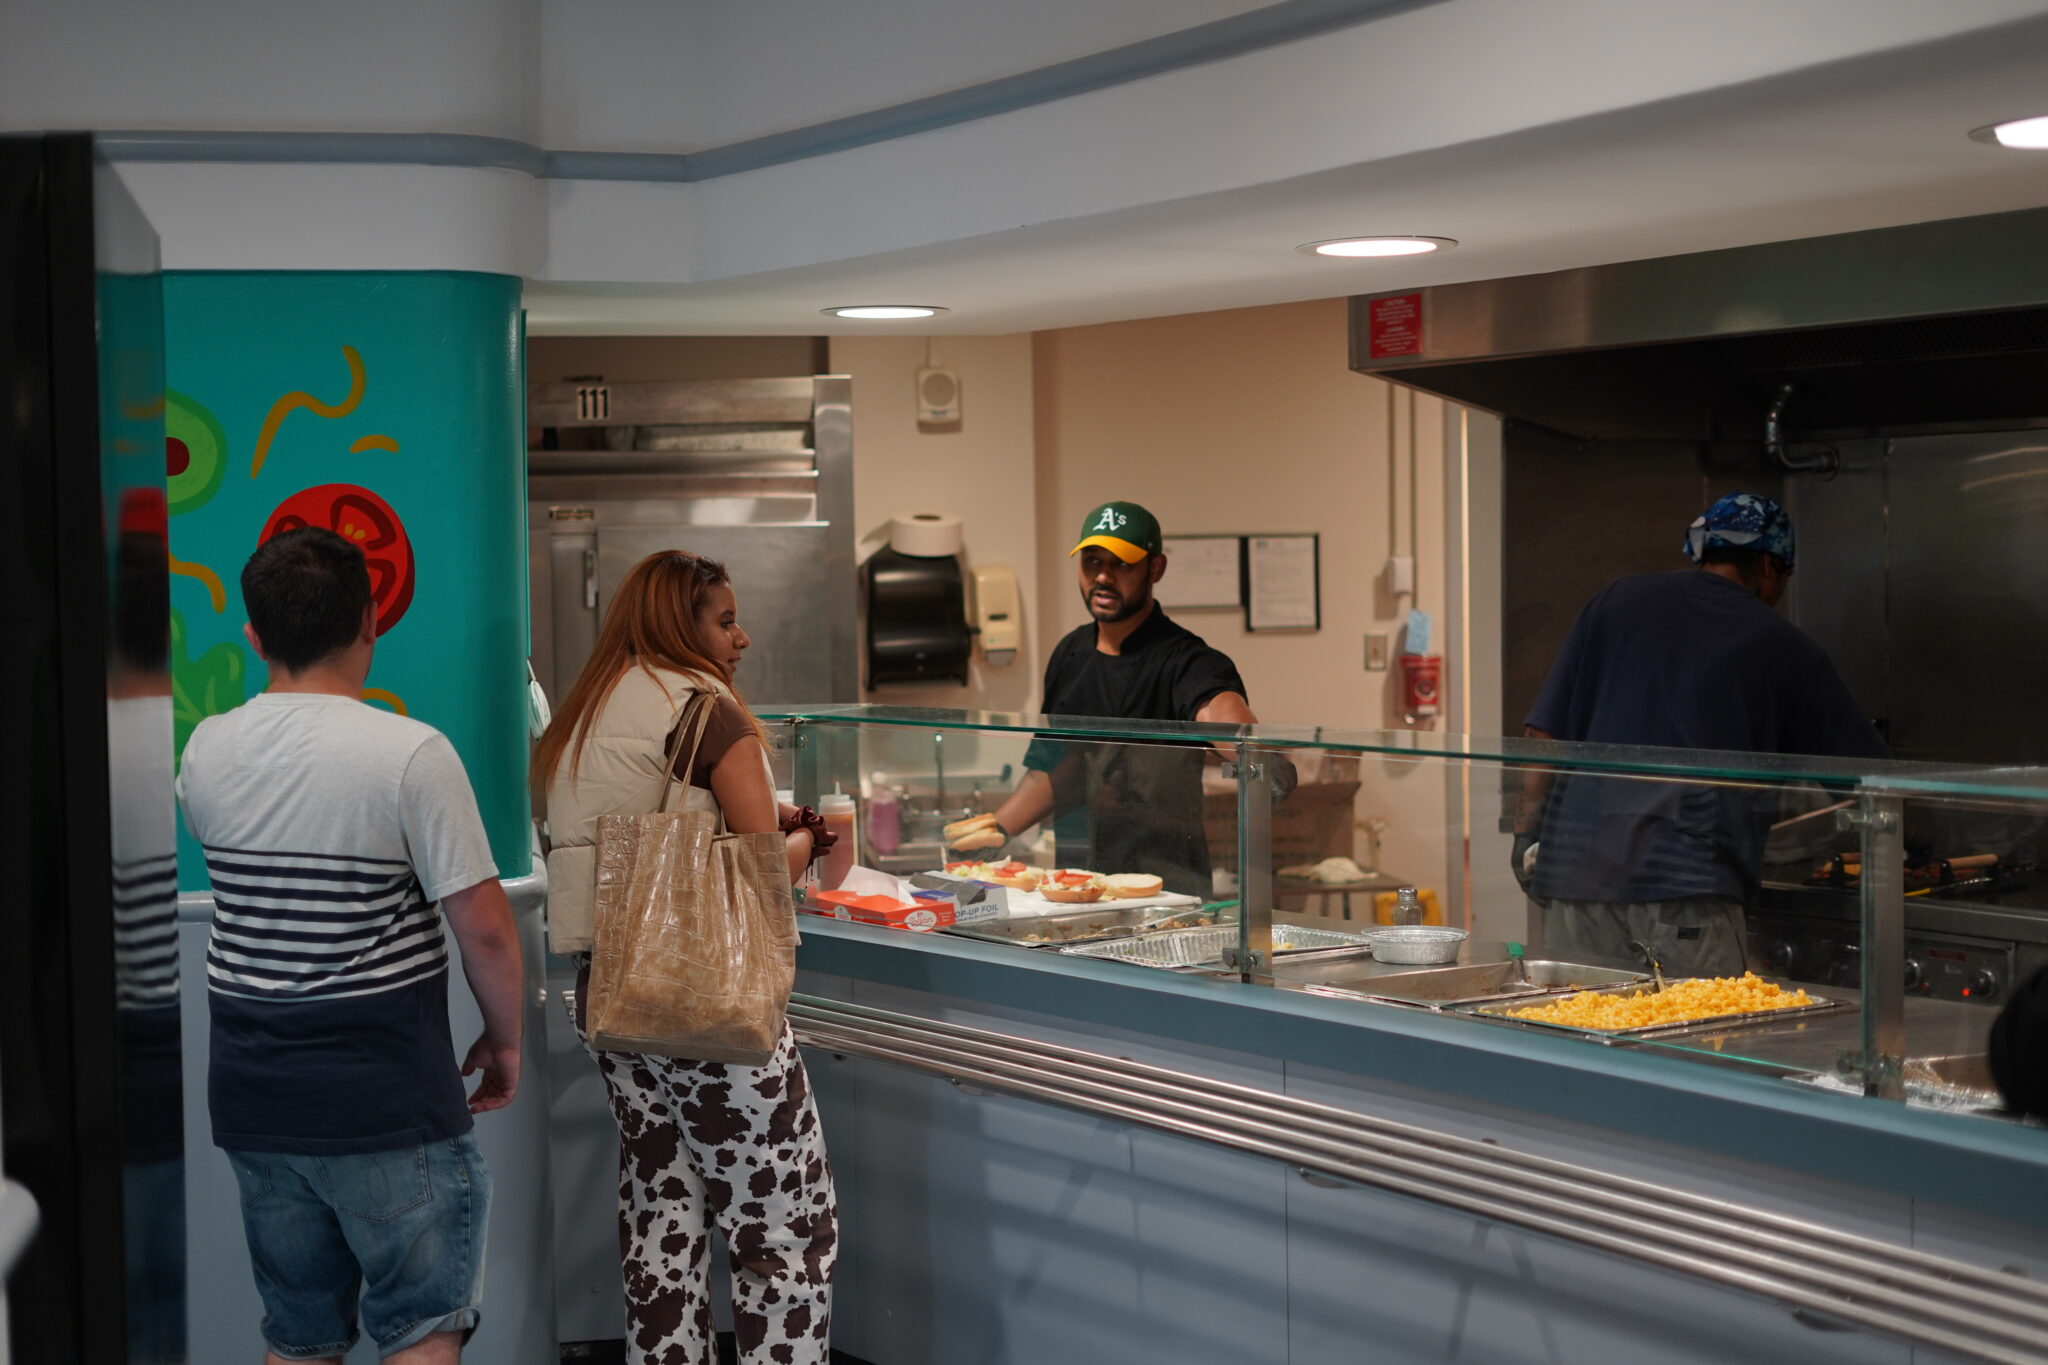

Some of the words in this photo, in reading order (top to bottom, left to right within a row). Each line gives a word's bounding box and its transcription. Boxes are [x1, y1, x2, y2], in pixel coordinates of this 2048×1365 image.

[578, 388, 608, 419] 111
[1092, 507, 1127, 531] A's
[954, 907, 980, 919] OP-UP
[981, 903, 999, 913] FOIL
